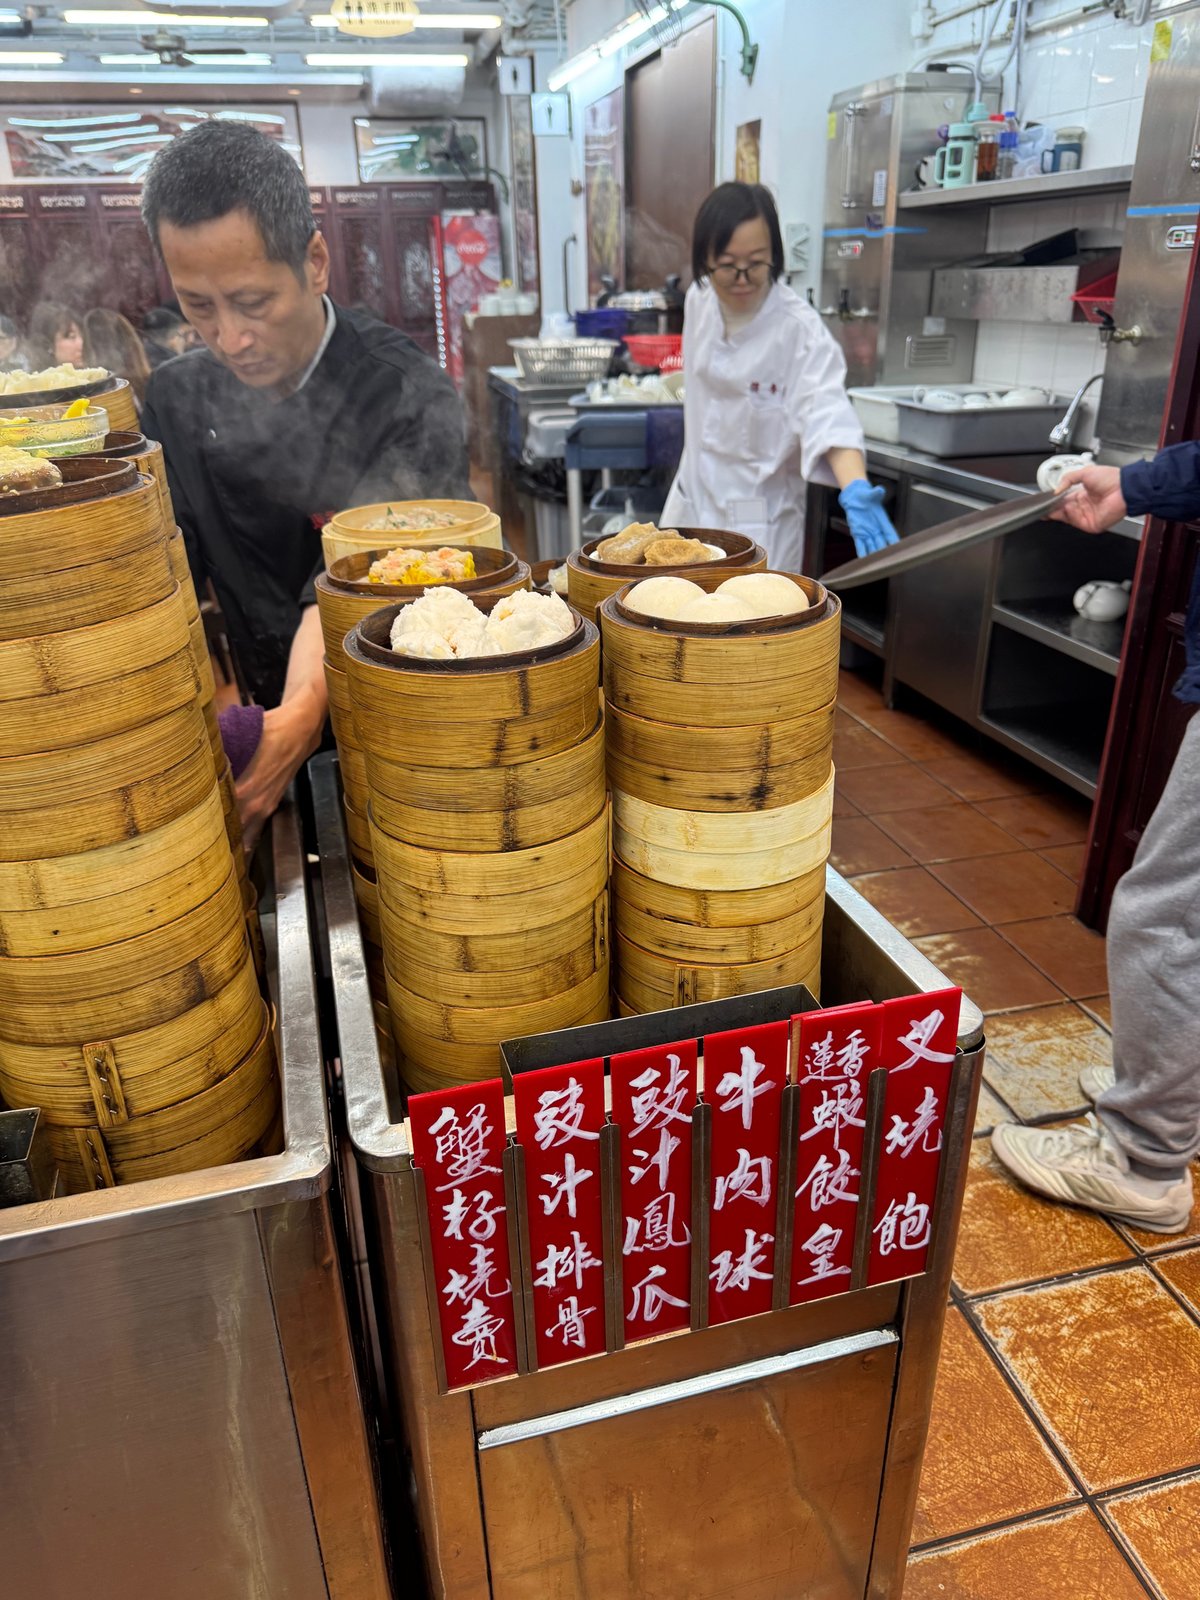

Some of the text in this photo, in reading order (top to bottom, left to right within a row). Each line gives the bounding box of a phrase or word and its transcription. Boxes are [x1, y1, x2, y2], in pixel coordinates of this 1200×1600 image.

[533, 1077, 603, 1348] 豉汁排骨
[622, 1054, 692, 1322] 豉汁鳳爪
[709, 1046, 777, 1293] 牛肉球
